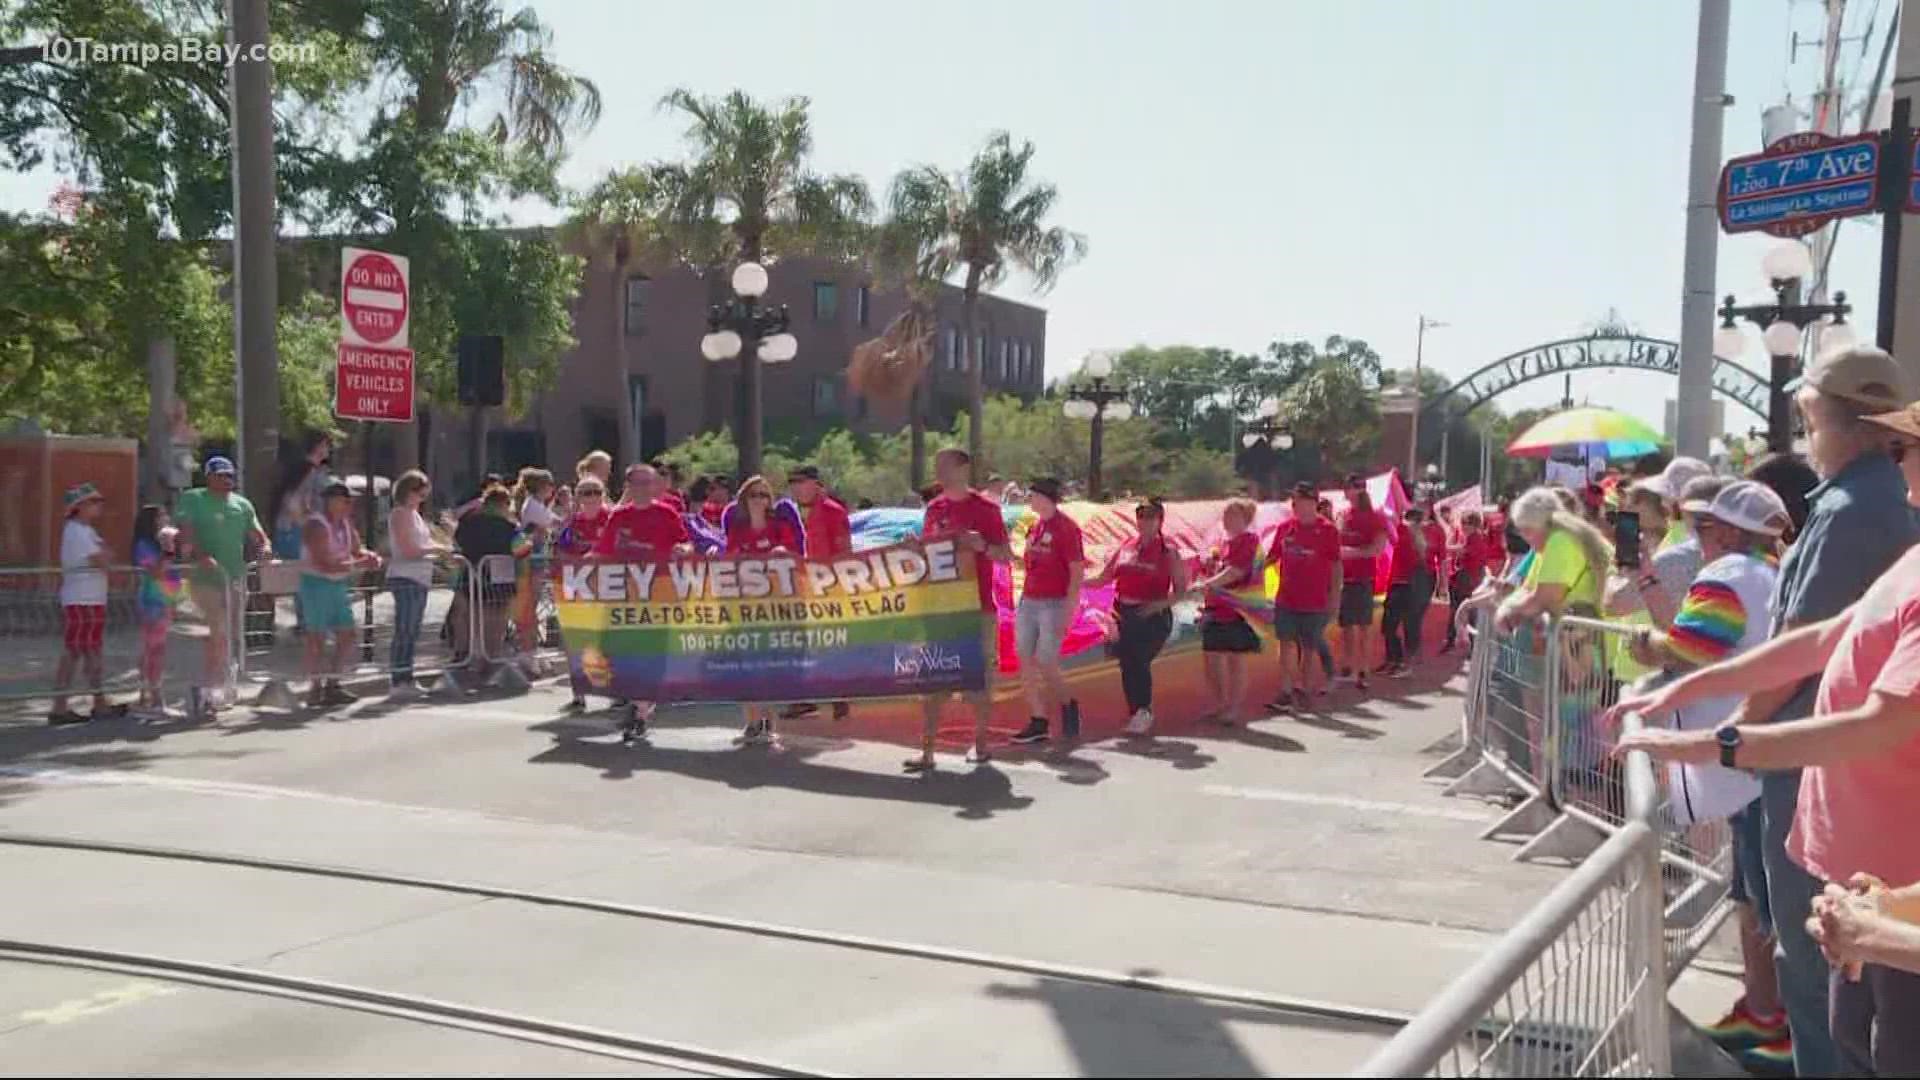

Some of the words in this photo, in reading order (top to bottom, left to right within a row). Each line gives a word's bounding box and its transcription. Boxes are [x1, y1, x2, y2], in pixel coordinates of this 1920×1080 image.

[1778, 157, 1810, 187] 7th
[1815, 150, 1872, 181] Ave
[352, 268, 369, 284] DO
[374, 271, 399, 288] NOT
[356, 310, 394, 328] ENTER
[339, 350, 412, 371] EMERGENCY
[346, 373, 404, 392] VEHICLES
[358, 397, 389, 414] ONLY
[562, 560, 656, 601] KEY
[668, 557, 797, 598] WEST
[807, 540, 958, 597] PRIDE
[610, 603, 730, 626] SEA-TO-SEA
[740, 598, 842, 621] RAINBOW
[852, 593, 907, 616] FLAG
[678, 632, 760, 651] 100-FOOT
[768, 628, 849, 649] SECTION
[894, 651, 922, 677] Key
